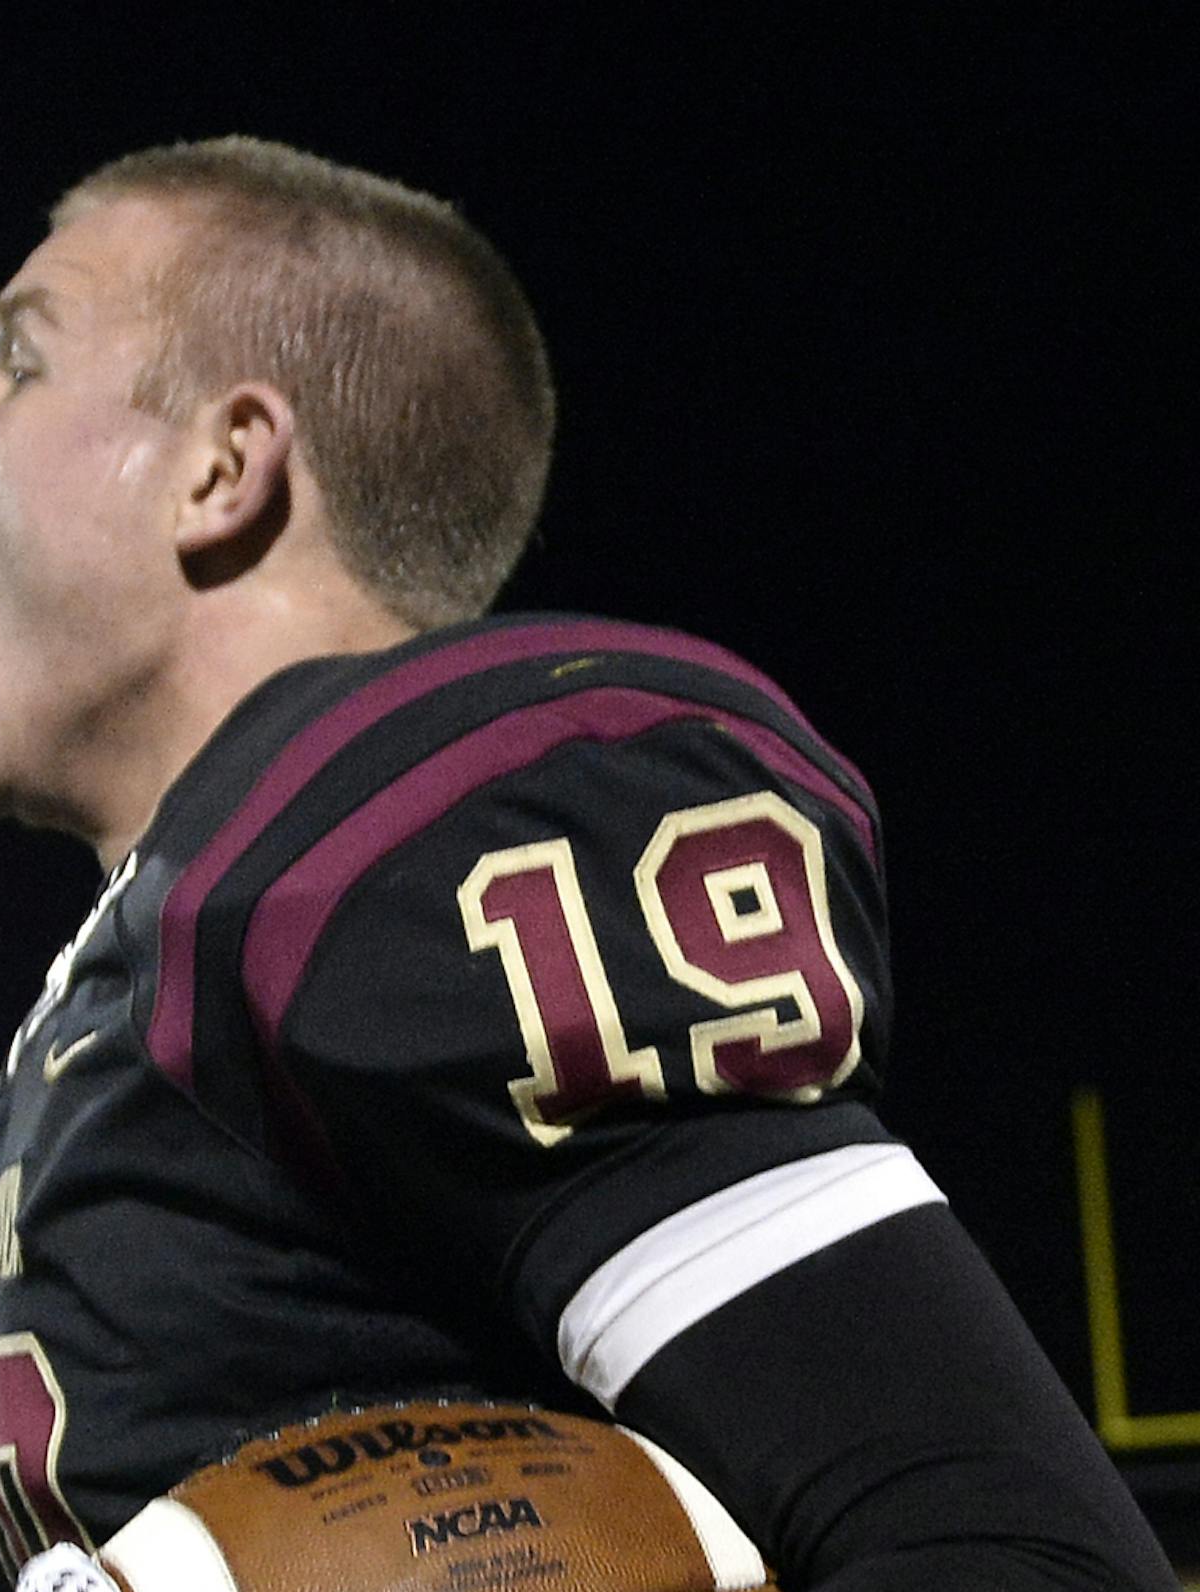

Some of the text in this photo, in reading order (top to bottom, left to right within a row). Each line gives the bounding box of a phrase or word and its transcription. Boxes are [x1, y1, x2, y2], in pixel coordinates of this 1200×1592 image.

[457, 790, 864, 1148] 19
[254, 1418, 568, 1488] Wilson
[403, 1496, 547, 1558] NCAA
